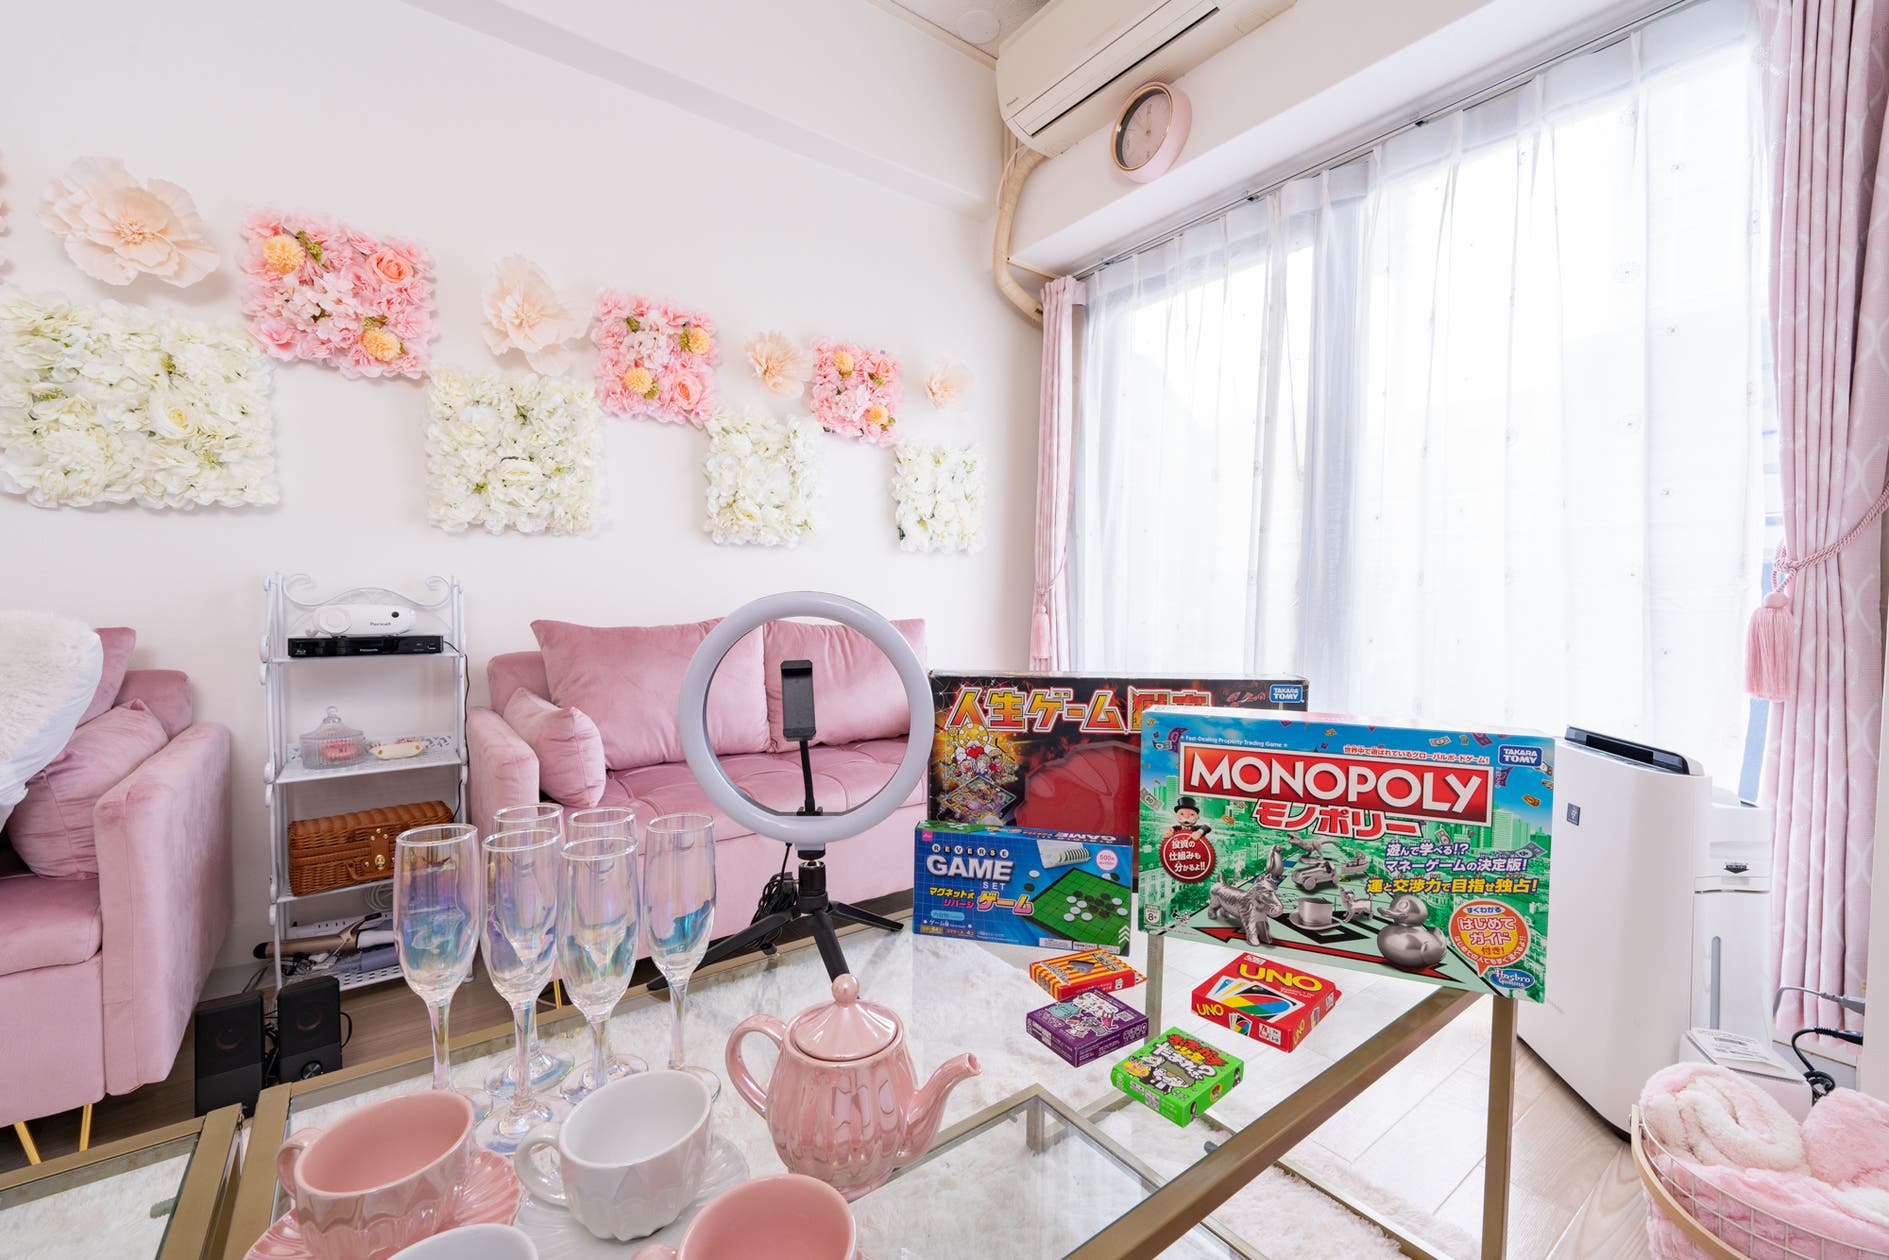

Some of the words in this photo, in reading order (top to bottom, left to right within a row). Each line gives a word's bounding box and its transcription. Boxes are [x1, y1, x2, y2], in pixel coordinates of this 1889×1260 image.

[945, 687, 1128, 733] 人生ゲーム
[1244, 739, 1264, 747] Trading
[1503, 748, 1538, 757] TAKARA
[1503, 755, 1538, 764] TOMY
[1190, 751, 1482, 814] MONOPOLY
[1254, 799, 1422, 839] モノポリー
[932, 843, 1009, 858] REVERSE
[1172, 840, 1195, 849] 投資の
[1386, 842, 1469, 857] 遊んで学べる!?
[1169, 852, 1201, 861] 仕組みも
[926, 854, 1014, 882] GAME
[1385, 858, 1528, 873] マネーゲームの決定版!
[929, 886, 975, 900] マグネット式
[982, 881, 1006, 890] SET
[1367, 878, 1538, 894] 運と交渉力で目指せ独占!
[977, 891, 1035, 915] ゲーム
[1458, 917, 1516, 930] はじめて
[1469, 932, 1512, 946] ガイド
[1238, 963, 1324, 992] UNO
[1494, 968, 1531, 983] Hasbro
[1196, 1003, 1224, 1017] UNO
[1293, 1018, 1305, 1045] UNO
